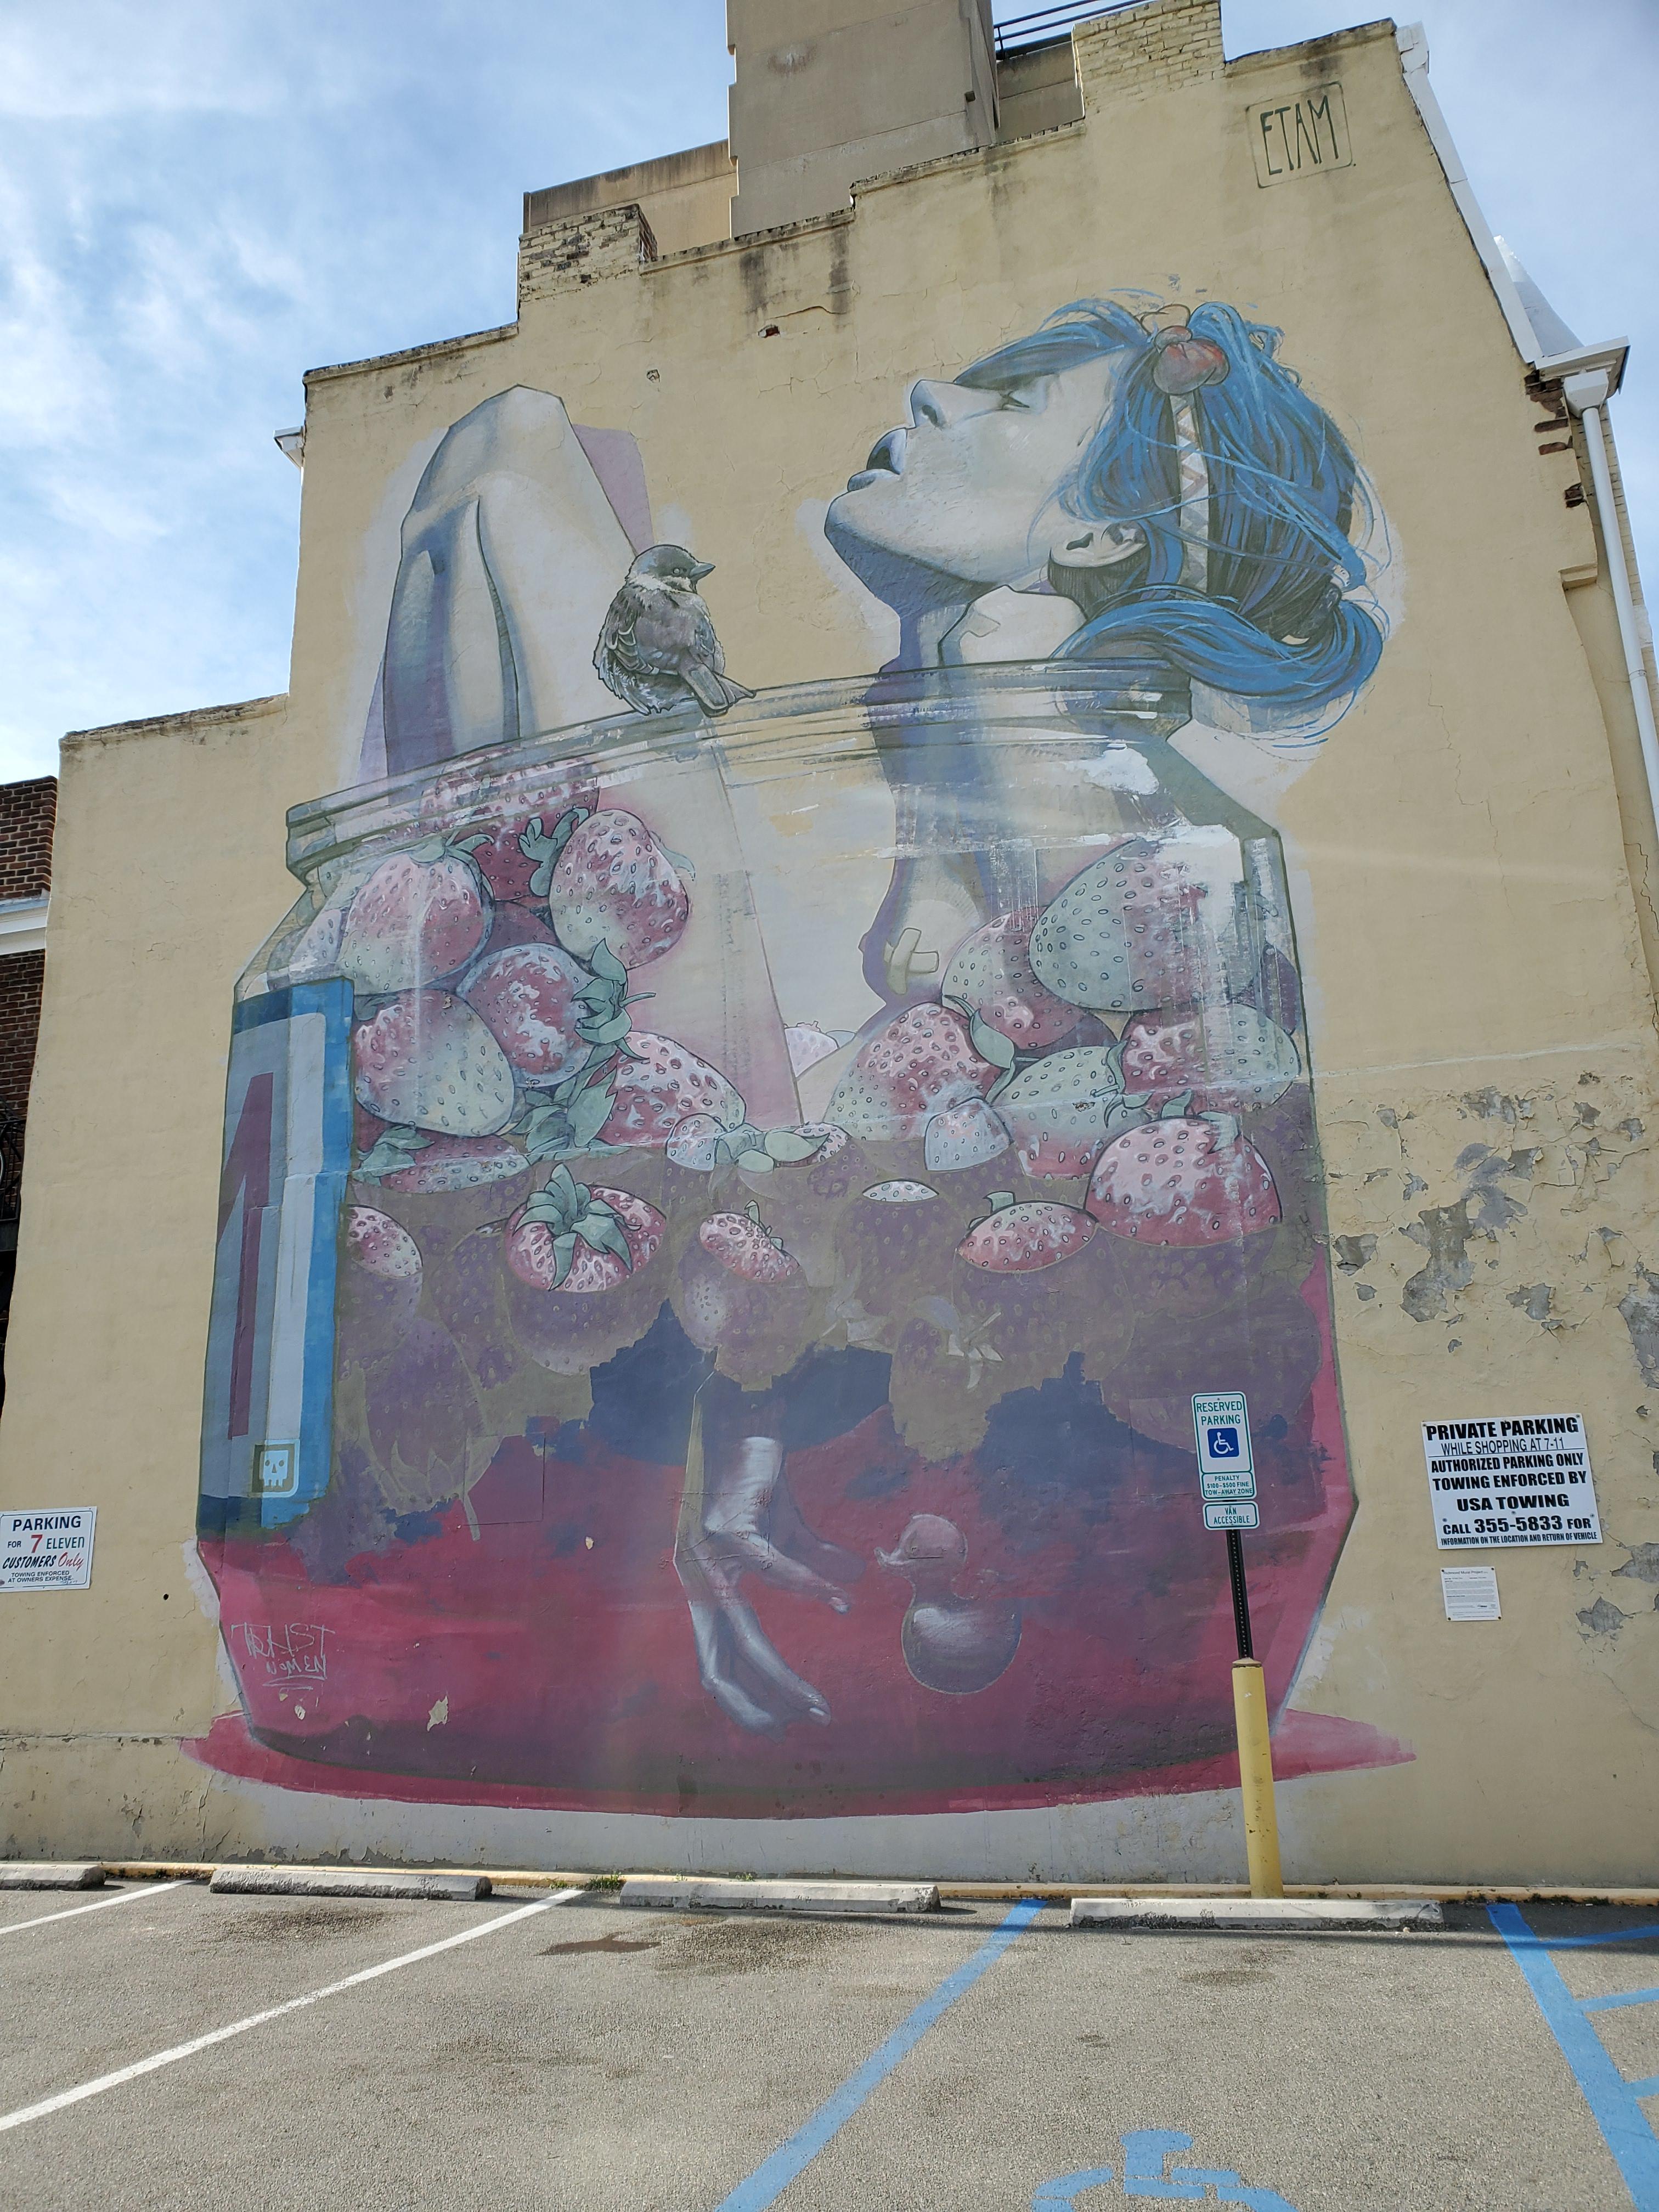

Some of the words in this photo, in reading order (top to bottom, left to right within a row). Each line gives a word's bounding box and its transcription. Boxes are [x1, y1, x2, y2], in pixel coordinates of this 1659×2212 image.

[1260, 95, 1338, 176] ETAM
[1196, 1401, 1242, 1413] RESERVED
[1201, 1414, 1240, 1426] PARKING
[1426, 1422, 1497, 1441] PRIVATE
[1500, 1417, 1579, 1437] PARKING
[1441, 1442, 1473, 1456] WHILE
[1475, 1438, 1527, 1454] SHOPPING
[1530, 1438, 1541, 1451] AT
[1544, 1437, 1564, 1450] 7-11
[1431, 1457, 1500, 1473] AUTHORIZED
[1503, 1454, 1554, 1469] PARKING
[1556, 1453, 1583, 1466] ONLY
[1432, 1475, 1491, 1491] TOWING
[1493, 1472, 1566, 1488] ENFORCED
[1568, 1471, 1587, 1484] BY
[1457, 1497, 1493, 1511] USA
[1496, 1494, 1570, 1510] TOWING
[12, 1515, 82, 1532] PARKING
[1214, 1515, 1250, 1524] ACCESSIBLE
[1443, 1523, 1471, 1534] CALL
[1474, 1515, 1563, 1533] 355-5833
[1567, 1517, 1592, 1530] FOR
[31, 1534, 43, 1553] 7
[1441, 1537, 1480, 1545] INFORMATION
[1501, 1534, 1528, 1543] LOCATION
[1530, 1534, 1541, 1542] AND
[1573, 1532, 1598, 1540] VEHICLE
[2, 1555, 57, 1569] CUSTOMERS
[58, 1552, 83, 1571] Only
